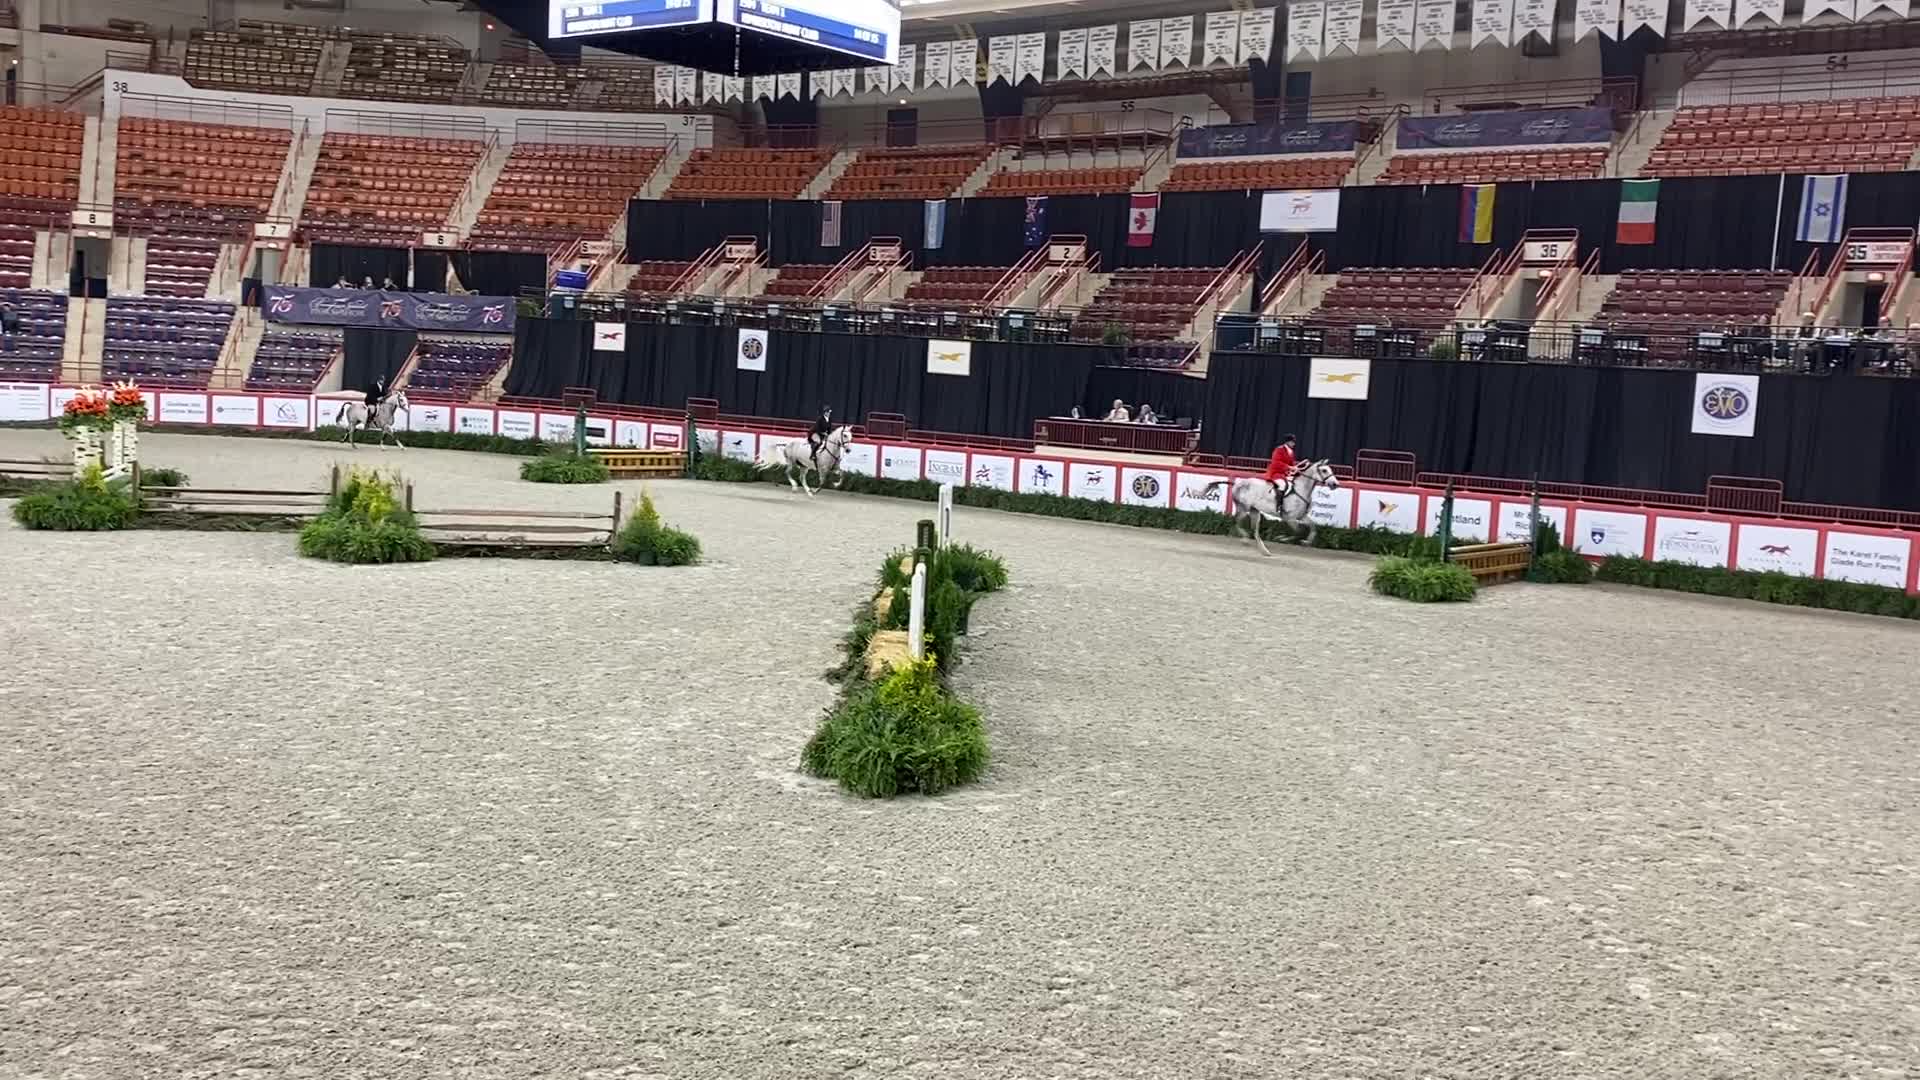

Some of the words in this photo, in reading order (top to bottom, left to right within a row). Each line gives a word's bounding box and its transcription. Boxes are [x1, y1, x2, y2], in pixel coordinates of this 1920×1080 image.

[1826, 55, 1849, 71] 54
[112, 81, 128, 93] 38
[1121, 101, 1135, 112] 55
[682, 116, 695, 126] 37
[270, 226, 277, 236] 7
[437, 235, 444, 244] 6
[871, 248, 877, 259] 3
[1063, 247, 1070, 258] 2
[1541, 244, 1557, 258] 36
[1847, 245, 1867, 260] 35
[270, 294, 295, 313] 75
[381, 299, 404, 318] 75
[482, 304, 505, 324] 75
